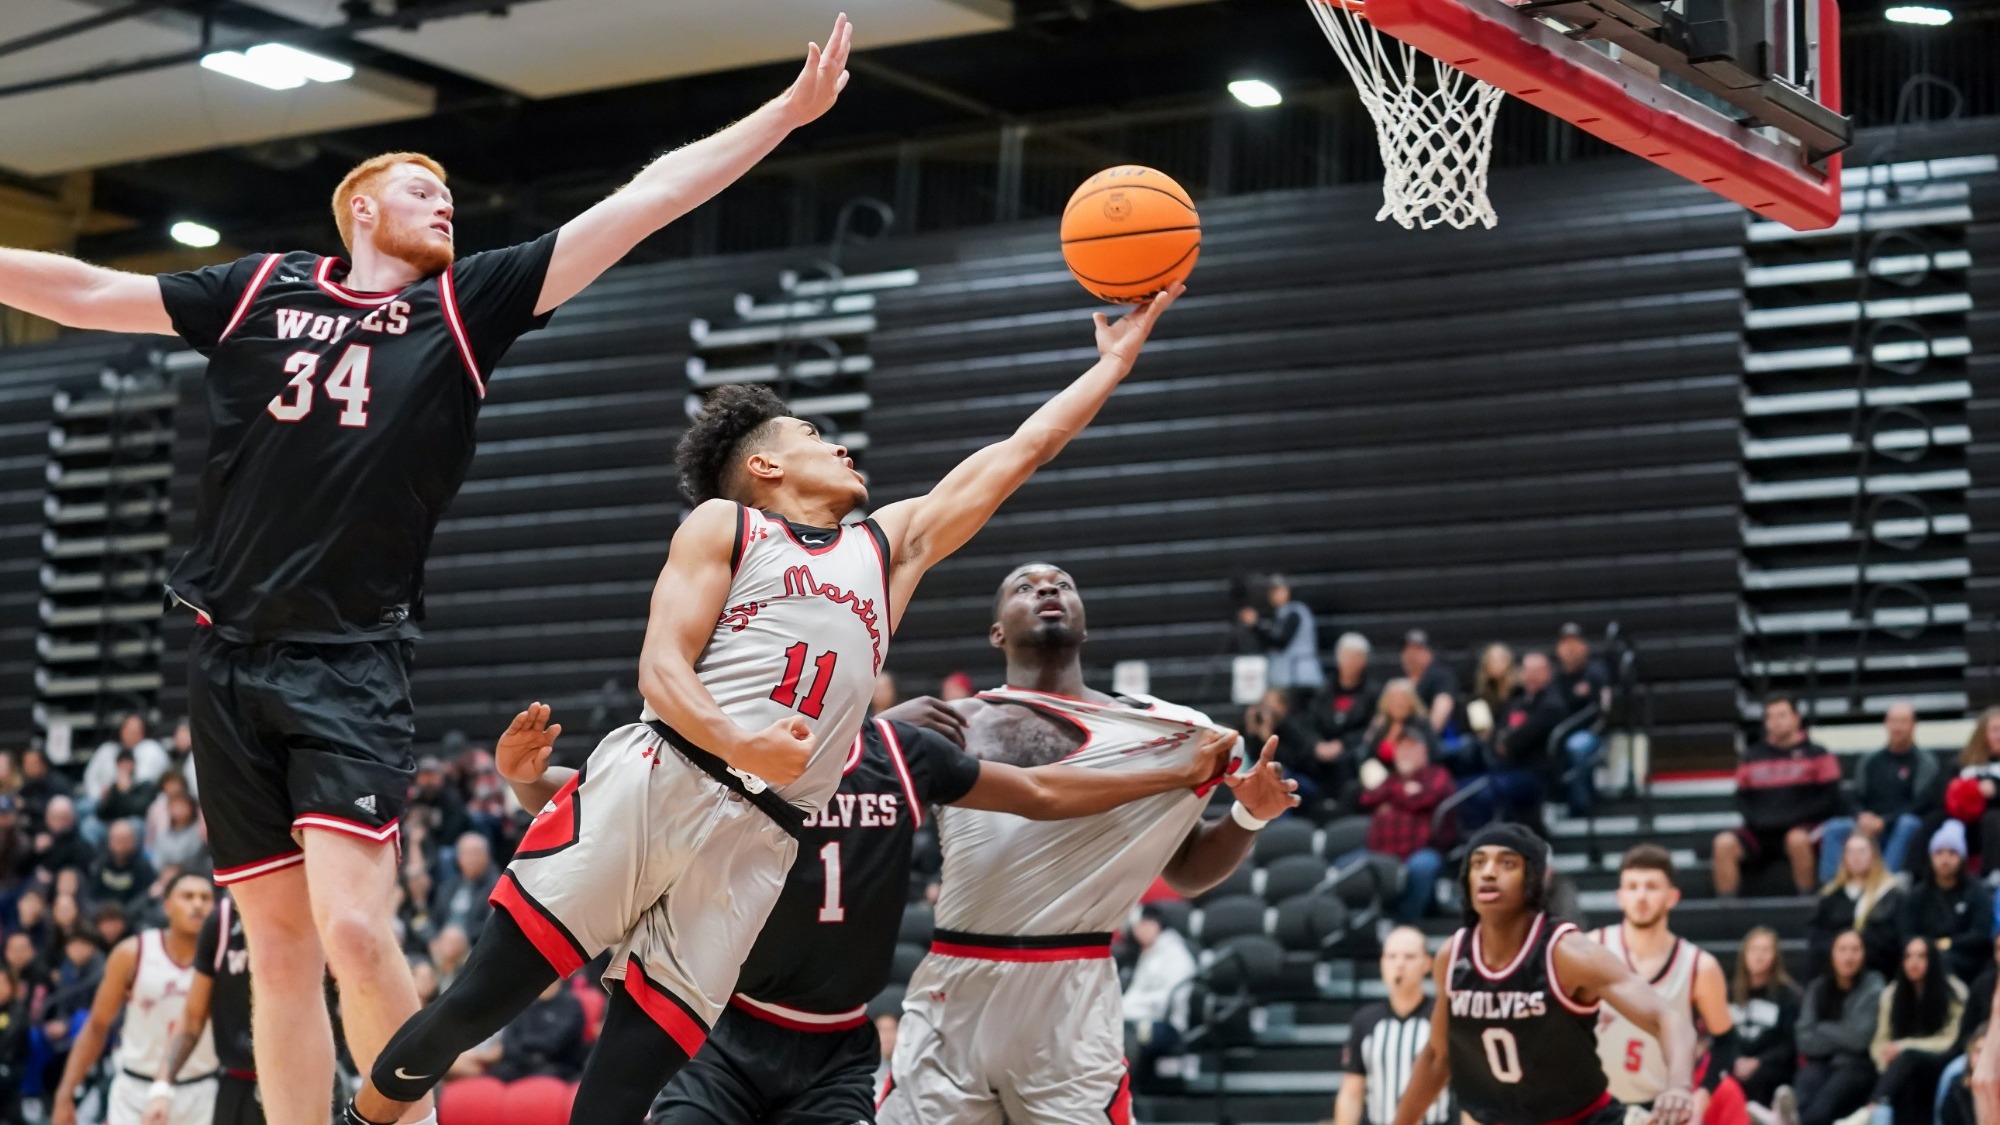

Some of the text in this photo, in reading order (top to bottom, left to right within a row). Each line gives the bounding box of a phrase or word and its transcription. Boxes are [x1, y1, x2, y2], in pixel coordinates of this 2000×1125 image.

[266, 343, 372, 428] 34
[769, 641, 838, 721] 11
[817, 840, 845, 924] 1
[1449, 989, 1547, 1020] WOLVES
[1481, 1027, 1524, 1084] 0
[1623, 1038, 1645, 1074] 5
